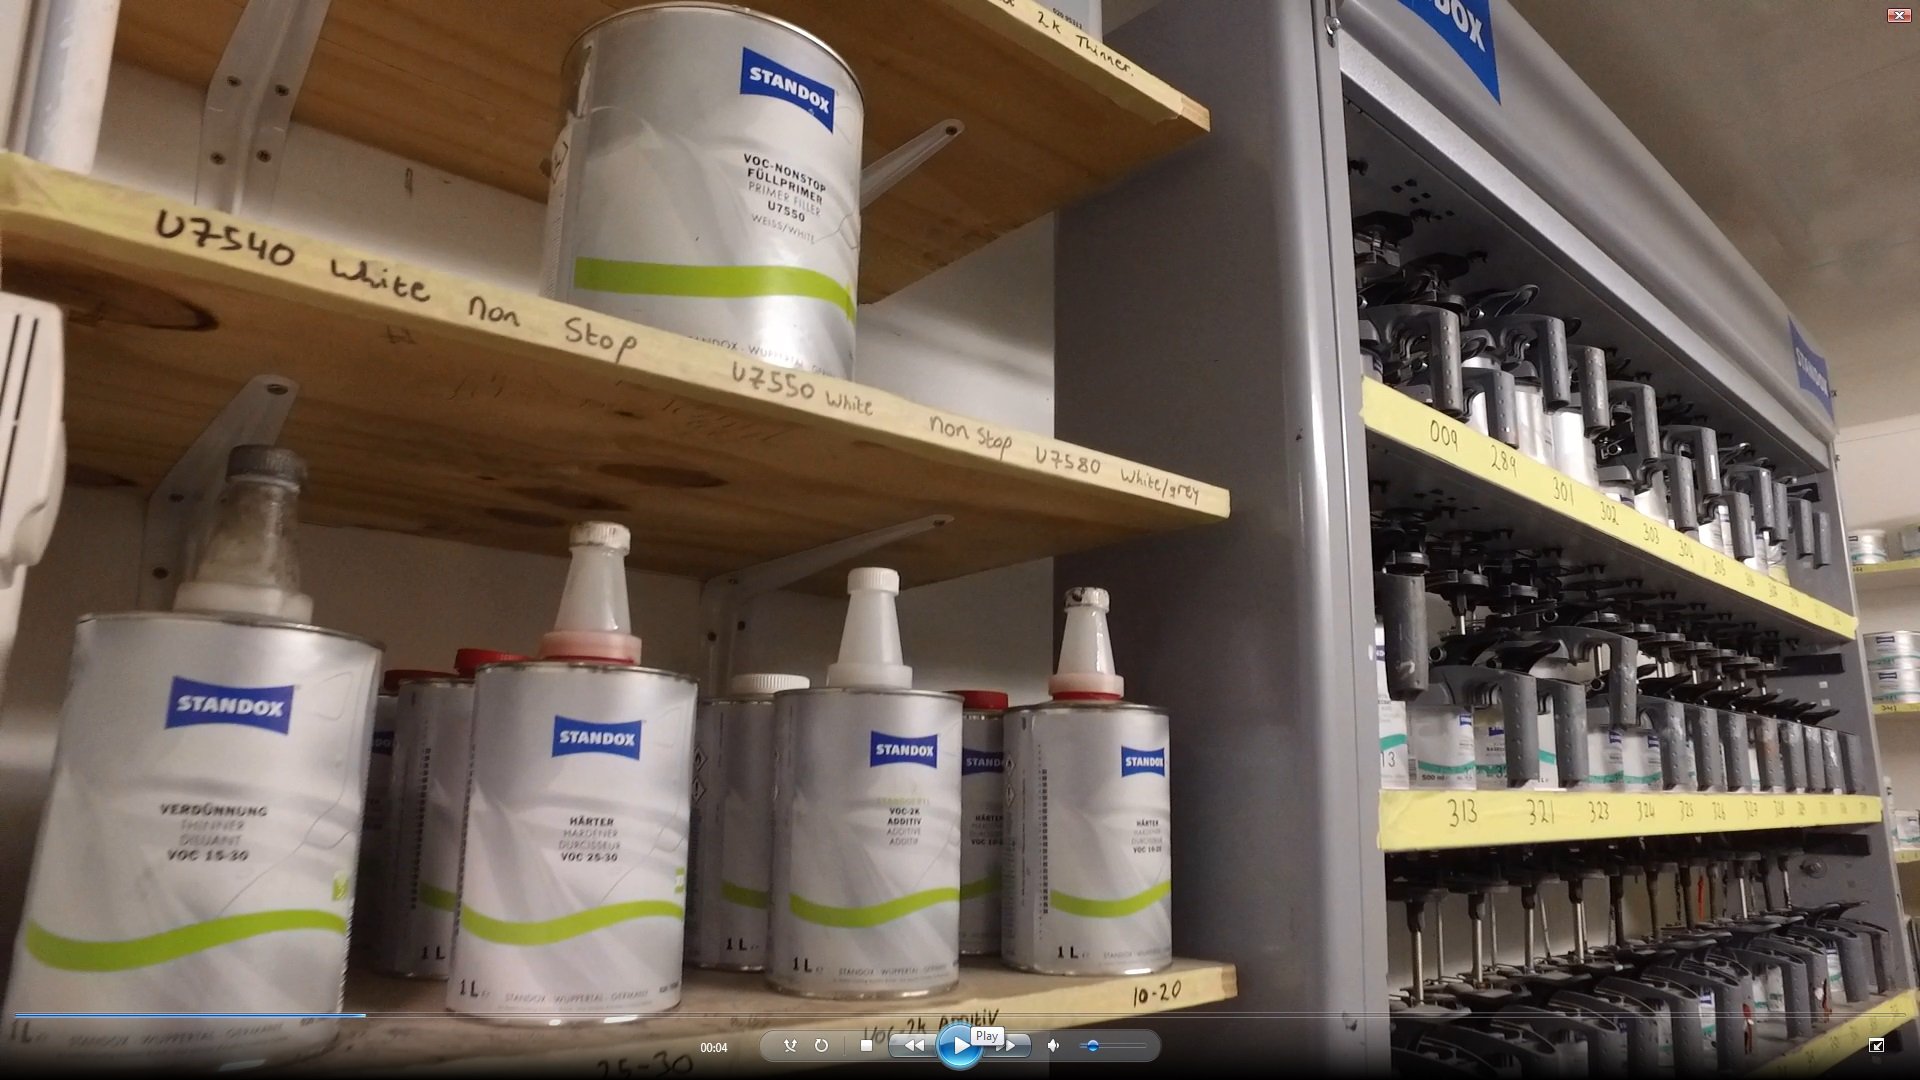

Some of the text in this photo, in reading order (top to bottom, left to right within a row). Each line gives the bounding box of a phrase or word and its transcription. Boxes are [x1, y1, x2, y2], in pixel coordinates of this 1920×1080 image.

[749, 65, 830, 114] STANDOX
[743, 153, 827, 193] VOC-NONSTOP
[747, 167, 823, 205] FÜLLPRIMER
[748, 181, 821, 217] PRIMER FILLER
[767, 200, 805, 222] U7550
[156, 209, 295, 267] U7540
[732, 360, 815, 401] U7550
[1035, 445, 1102, 475] U7580
[1430, 419, 1458, 452] 009
[1490, 444, 1518, 478] 289
[1553, 476, 1574, 507] 301
[176, 694, 285, 718] STANDOX
[560, 729, 636, 747] STANDOX
[875, 743, 934, 758] STANDOX
[966, 757, 1002, 768] STAND
[160, 802, 269, 817] VERDÜNNUNG
[570, 815, 614, 827] HÄRTER
[887, 817, 922, 826] ADDITIV
[1448, 798, 1479, 829] 313
[1528, 798, 1556, 826] 321
[167, 849, 200, 862] VOC
[561, 852, 583, 863] VOC
[1133, 980, 1182, 1008] 10-20
